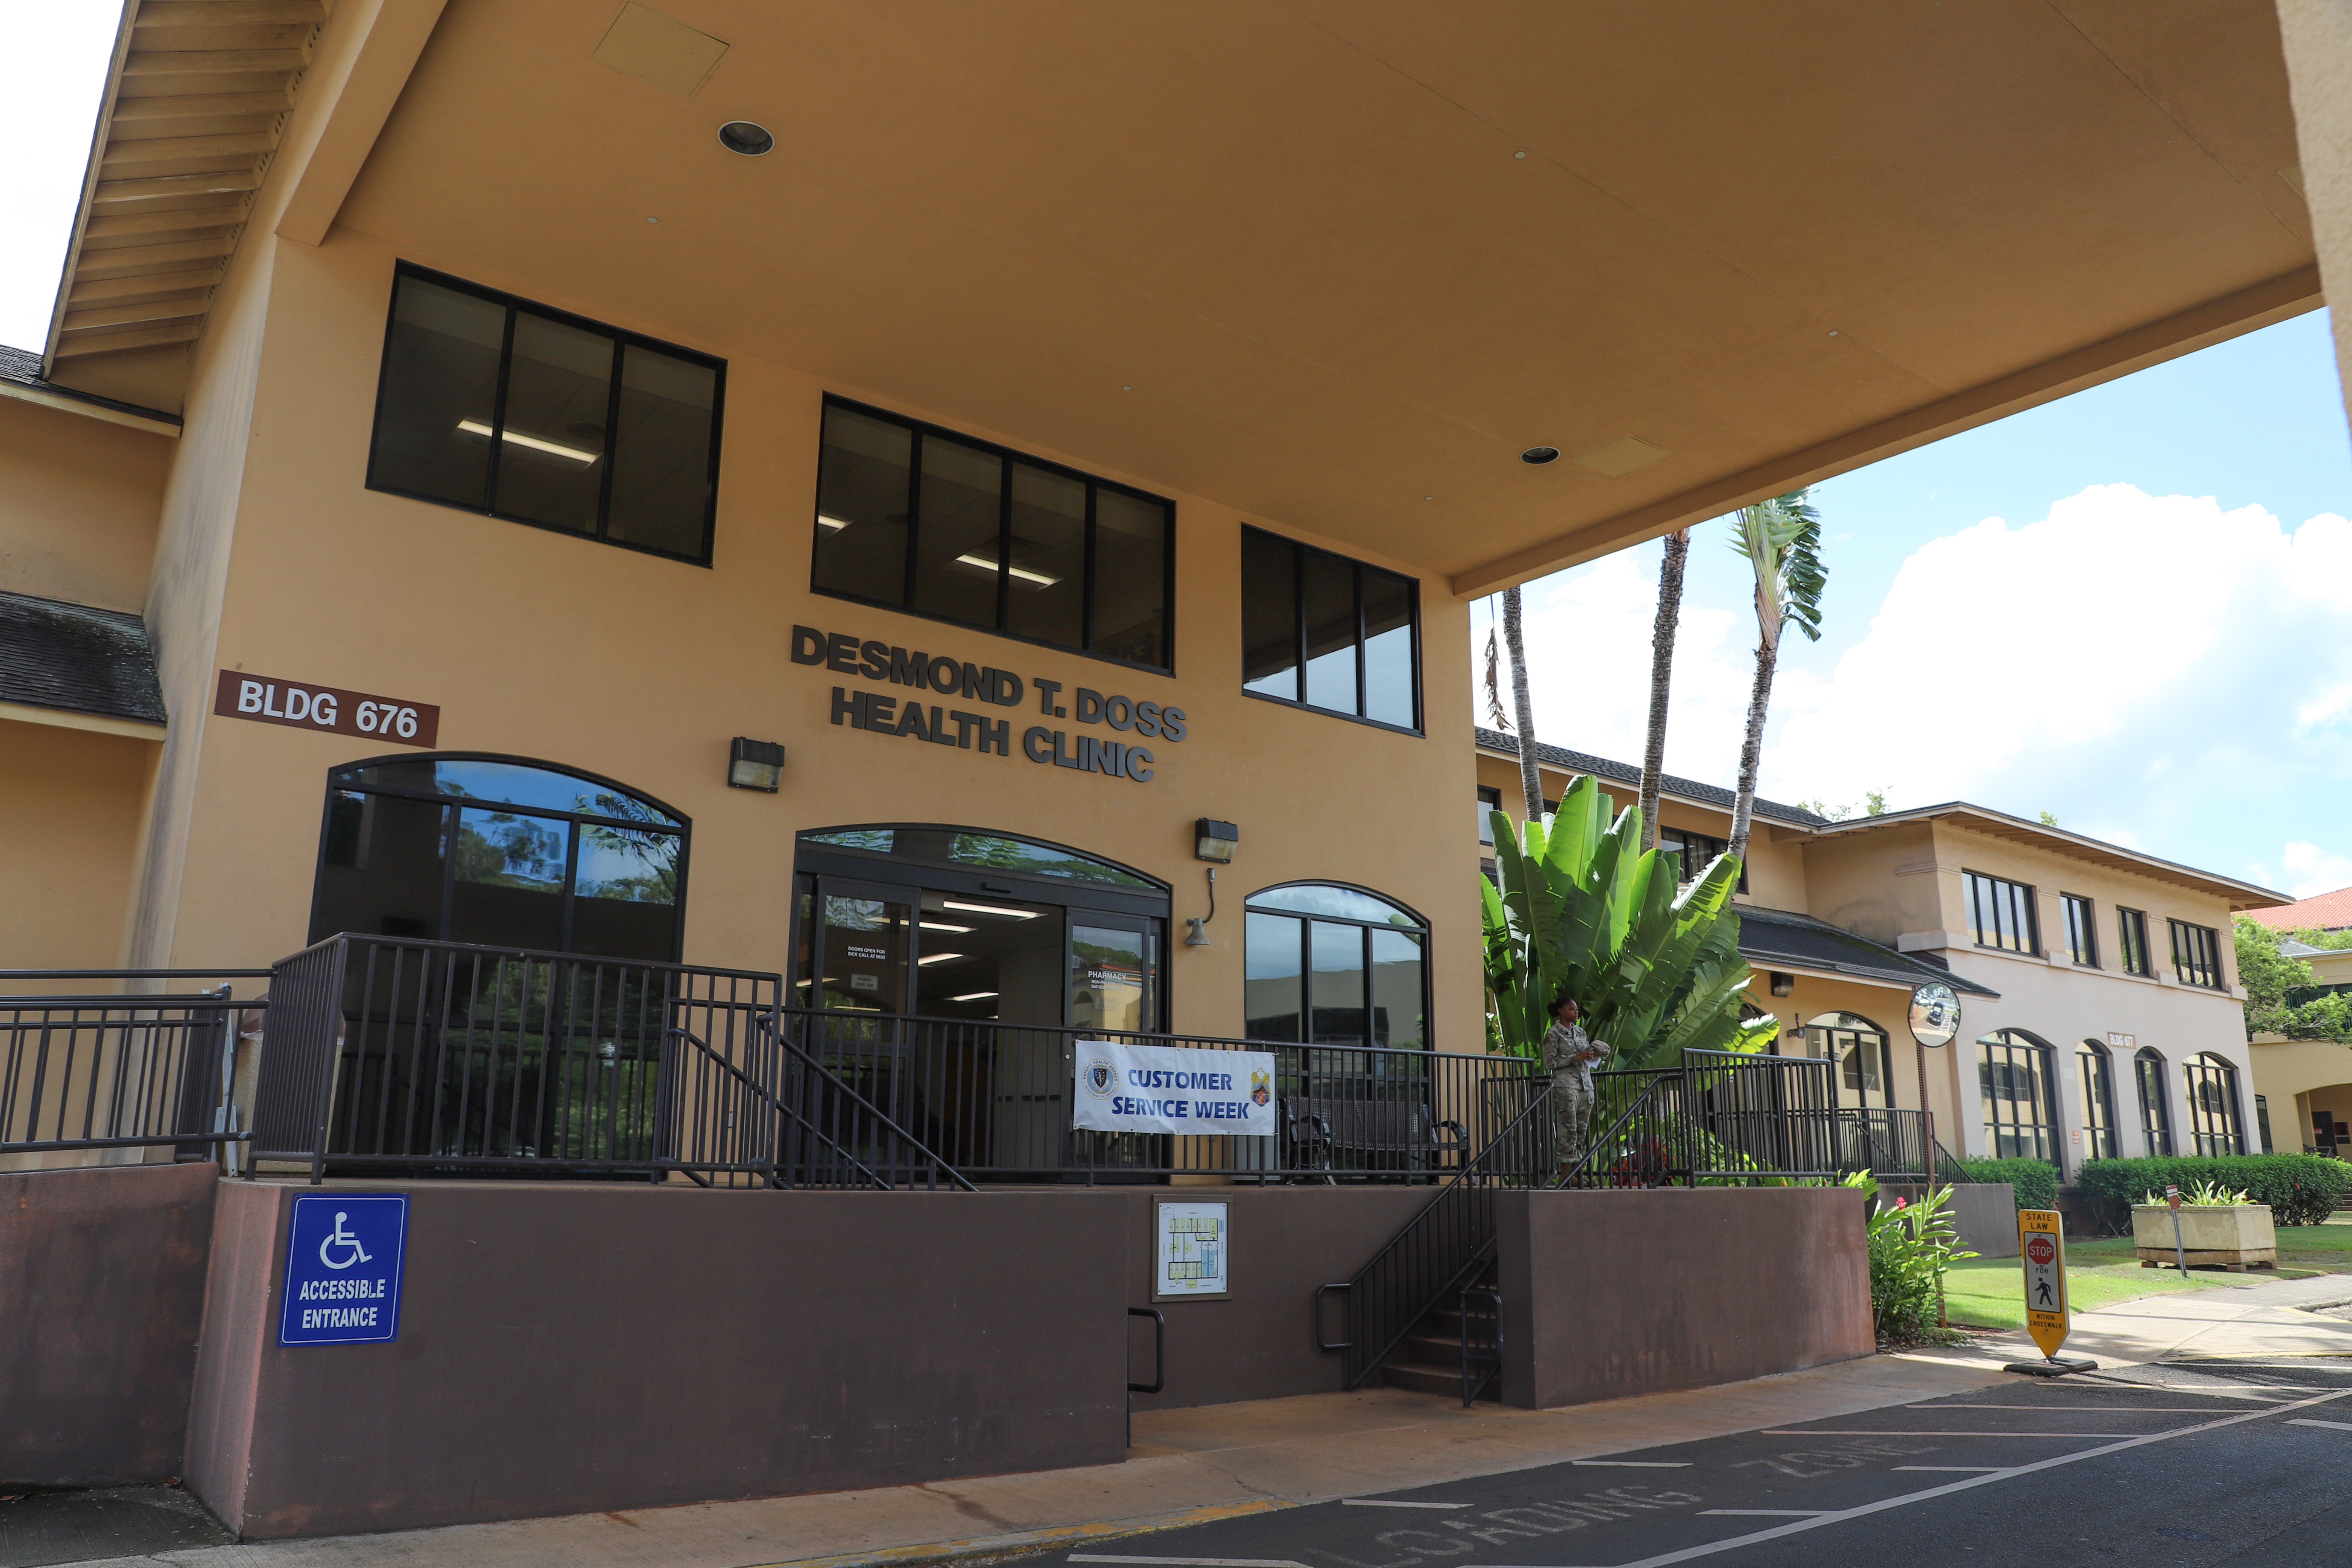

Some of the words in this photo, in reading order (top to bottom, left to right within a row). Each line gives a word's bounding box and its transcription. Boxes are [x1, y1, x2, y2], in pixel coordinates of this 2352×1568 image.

[791, 624, 1024, 707] DESMOND
[1034, 678, 1066, 718] T.
[1077, 687, 1187, 742] DOSS
[237, 680, 338, 726] BLDG
[356, 700, 418, 738] 676
[830, 686, 1009, 756] HEALTH
[1024, 726, 1155, 782] CLINIC
[1088, 971, 1127, 980] PHARMACY
[2110, 1034, 2124, 1046] BLDG
[2124, 1036, 2133, 1047] 677
[1083, 1063, 1092, 1080] DEFENSE
[1109, 1065, 1118, 1081] AGENCY
[1128, 1069, 1232, 1090] CUSTOMER
[1112, 1096, 1188, 1118] SERVICE
[1195, 1101, 1250, 1119] WEEK
[2026, 1213, 2052, 1222] STATE
[2030, 1246, 2052, 1257] STOP
[299, 1279, 386, 1300] ACCESSIBLE
[302, 1307, 378, 1329] ENTRANCE
[2029, 1320, 2063, 1329] CROSSWALK
[1303, 1486, 1703, 1568] LOADING
